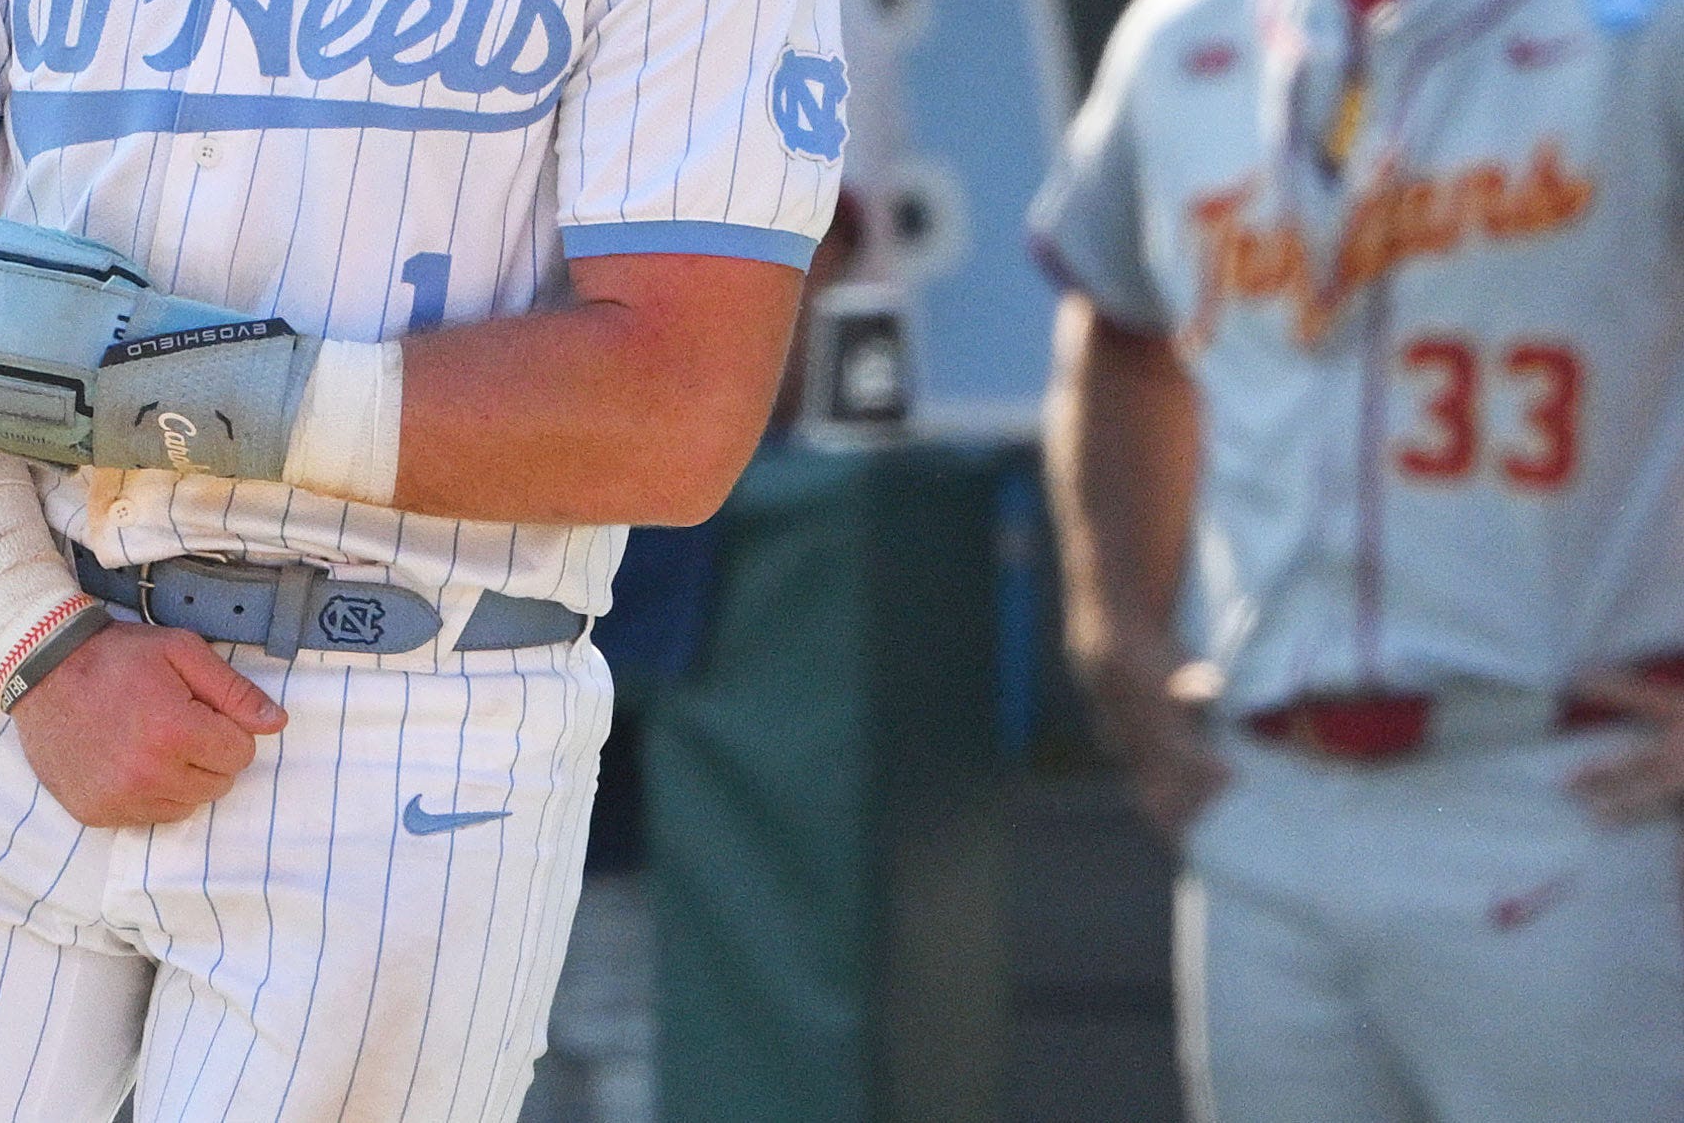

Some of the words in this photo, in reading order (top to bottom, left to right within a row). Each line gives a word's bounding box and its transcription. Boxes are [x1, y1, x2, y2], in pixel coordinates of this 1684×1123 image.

[400, 251, 452, 331] 1
[127, 323, 267, 356] EVOSHIELD
[1402, 339, 1582, 490] 33
